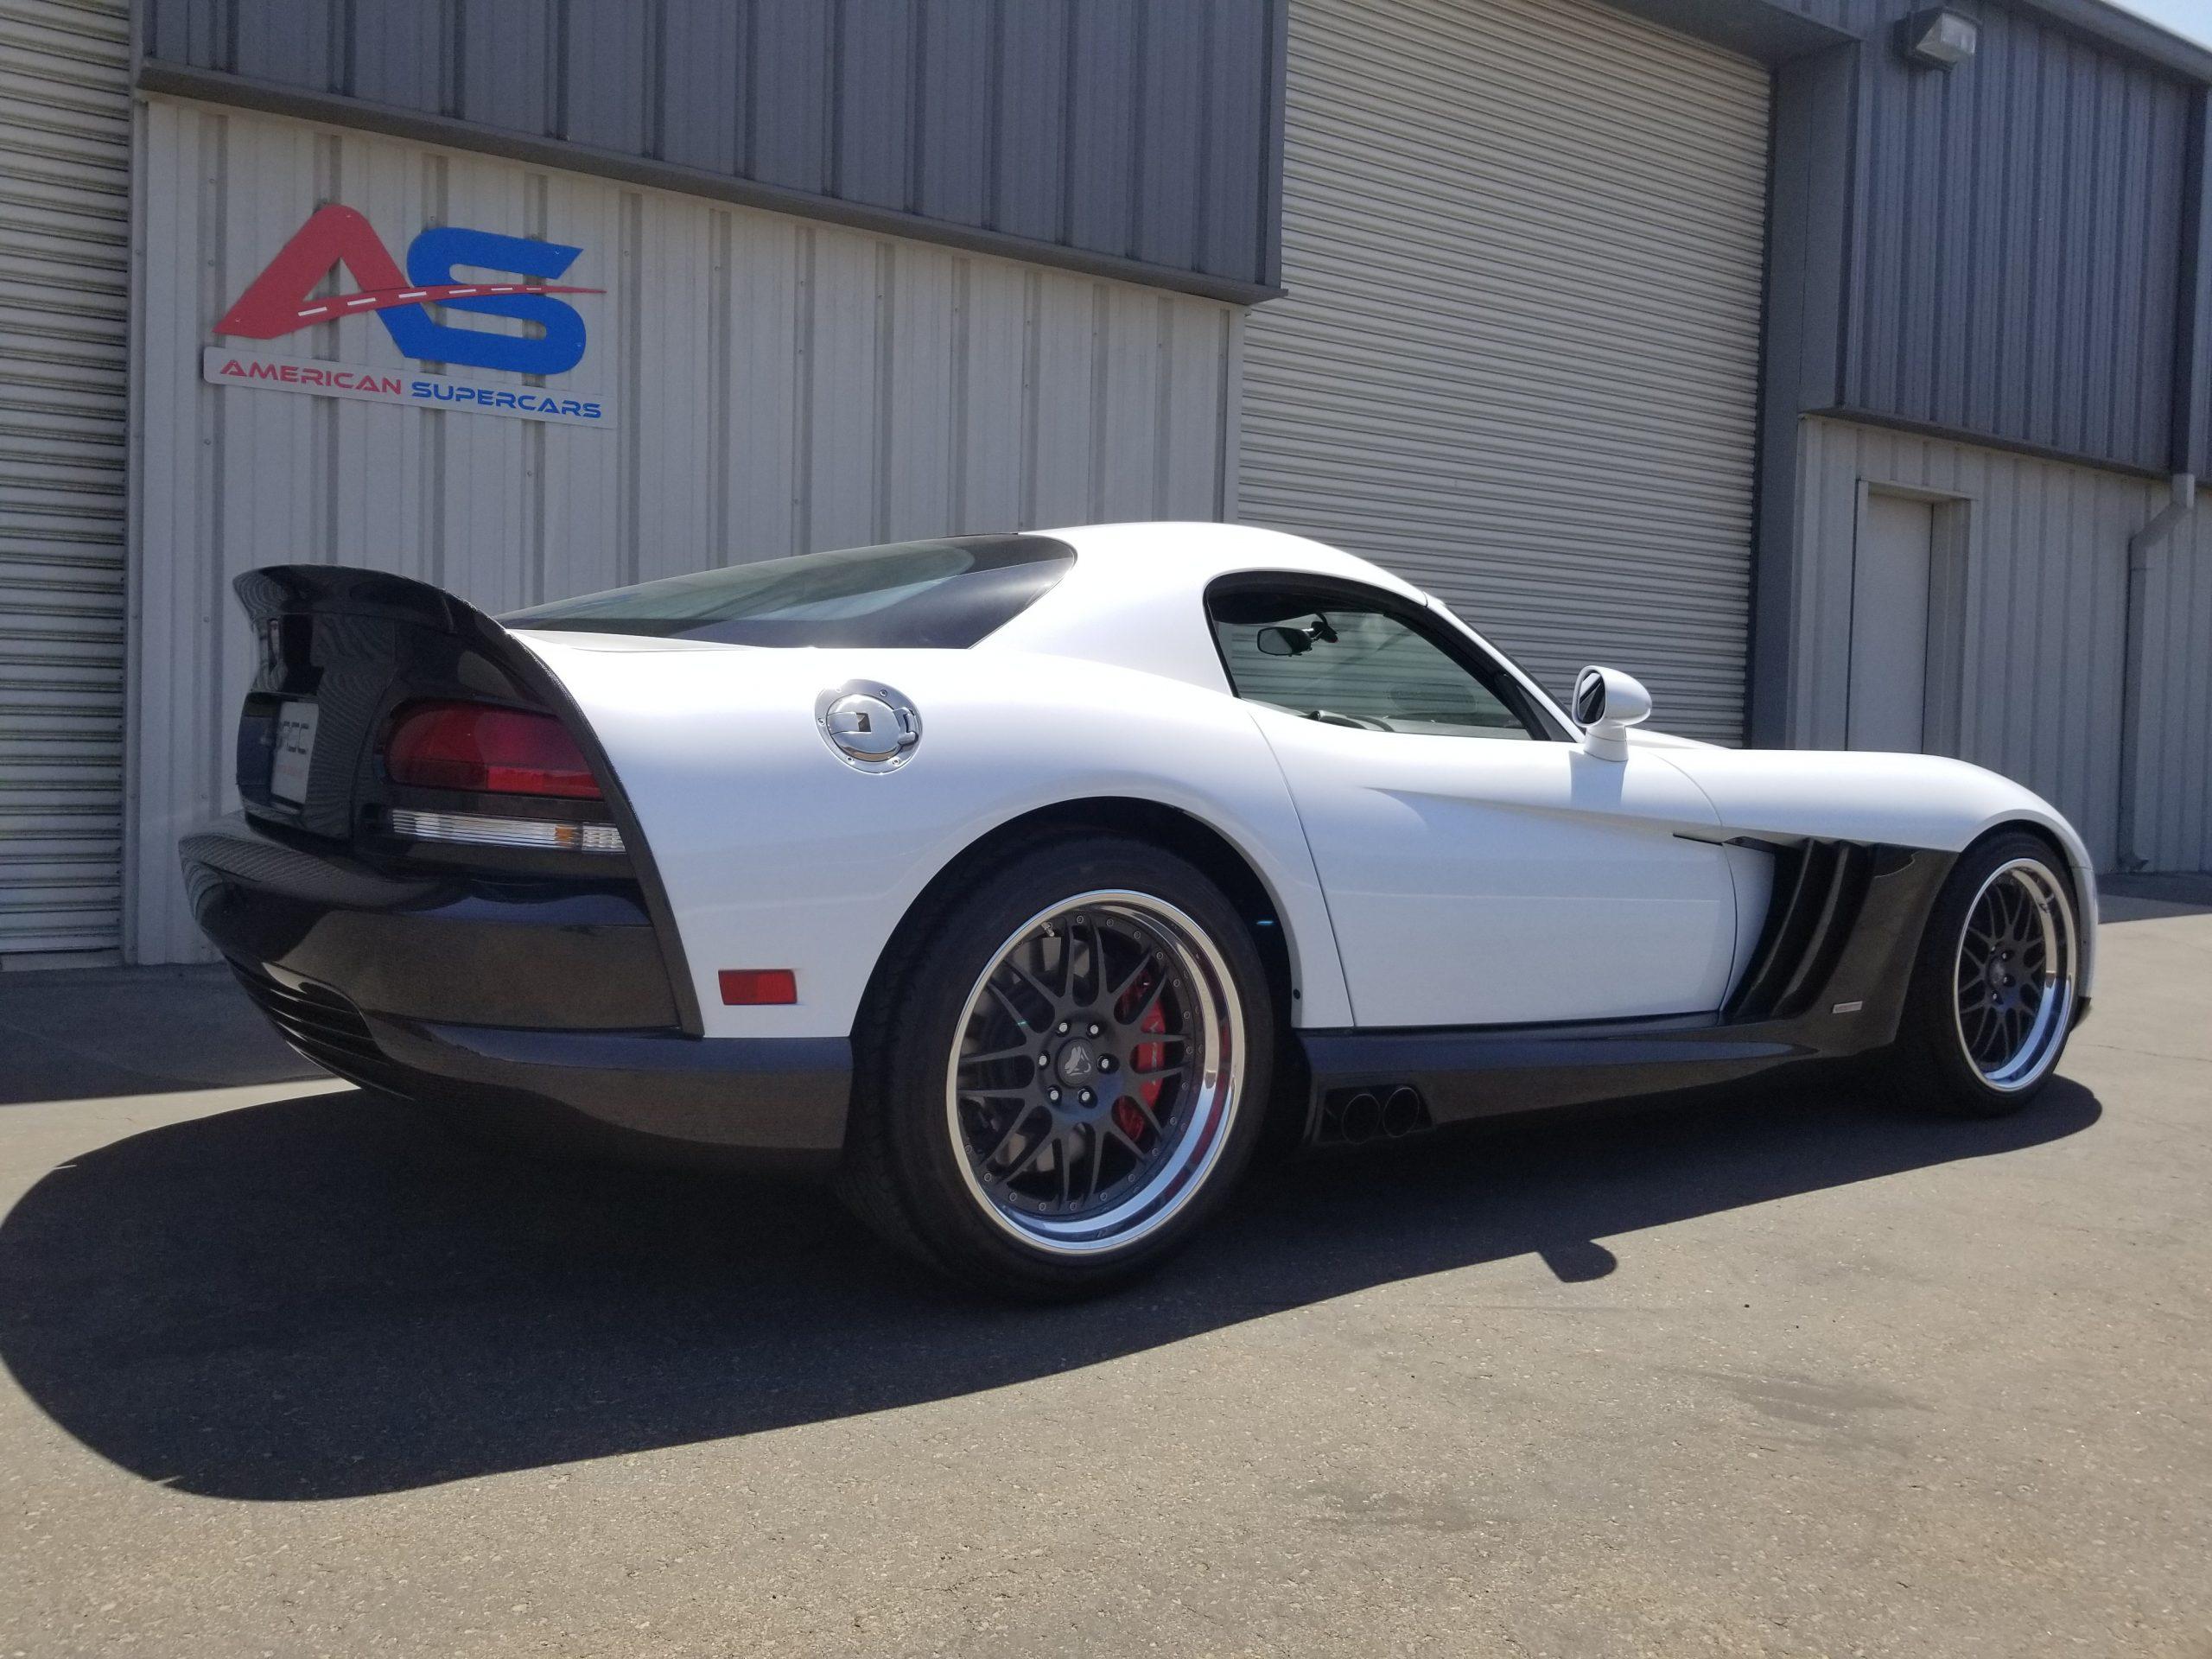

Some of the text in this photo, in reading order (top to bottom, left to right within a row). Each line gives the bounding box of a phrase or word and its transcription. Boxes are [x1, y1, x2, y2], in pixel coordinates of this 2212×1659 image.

[213, 204, 588, 376] AS
[219, 359, 602, 418] AMERICAN SUPERCARS
